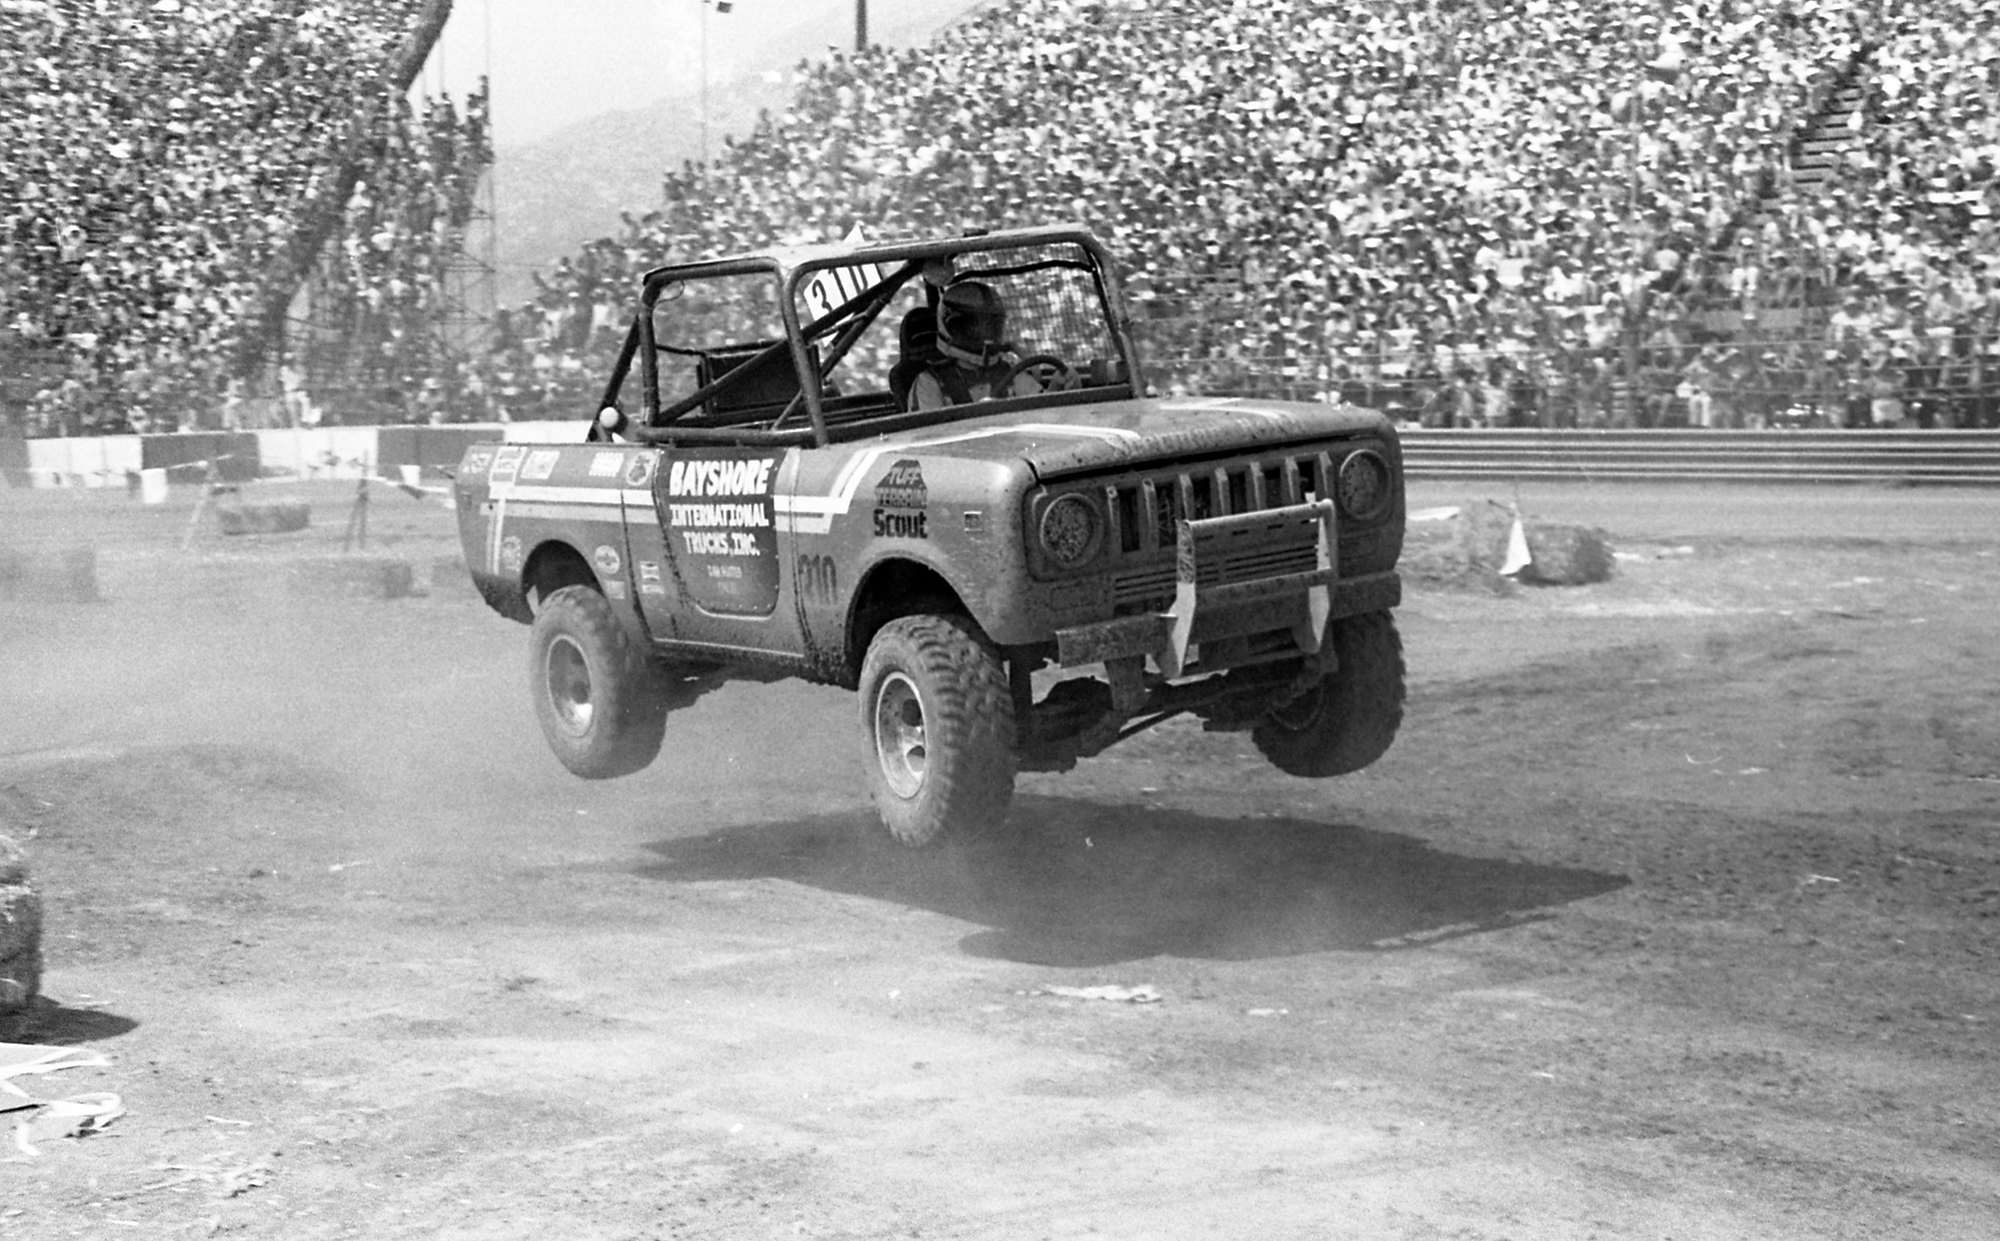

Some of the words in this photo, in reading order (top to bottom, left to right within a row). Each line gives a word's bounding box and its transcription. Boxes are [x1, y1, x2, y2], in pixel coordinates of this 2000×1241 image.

[669, 458, 775, 496] BAYSHORE
[890, 466, 922, 486] TUFF
[669, 503, 770, 527] INTERNATIONAL
[873, 508, 928, 539] Scout
